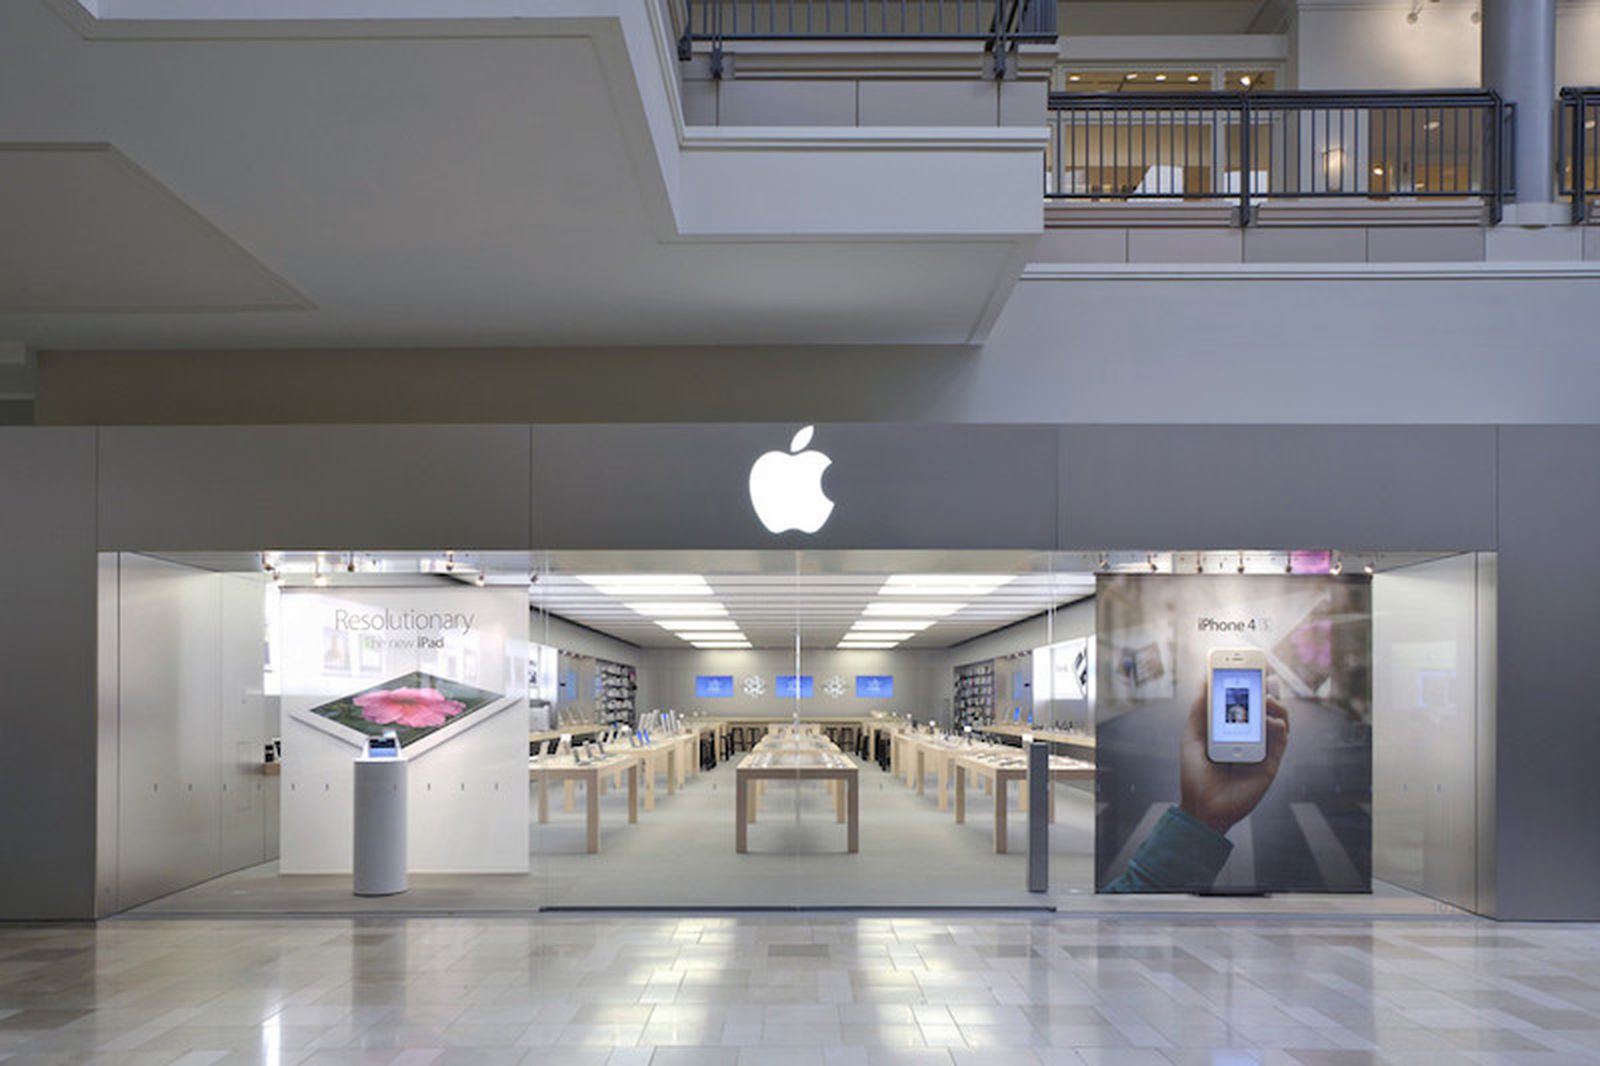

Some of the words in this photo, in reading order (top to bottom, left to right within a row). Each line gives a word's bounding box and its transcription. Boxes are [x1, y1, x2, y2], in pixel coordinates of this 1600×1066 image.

[335, 608, 475, 635] Resolutionary
[1197, 617, 1246, 632] iPhone
[389, 639, 414, 648] new
[417, 635, 444, 648] iPad
